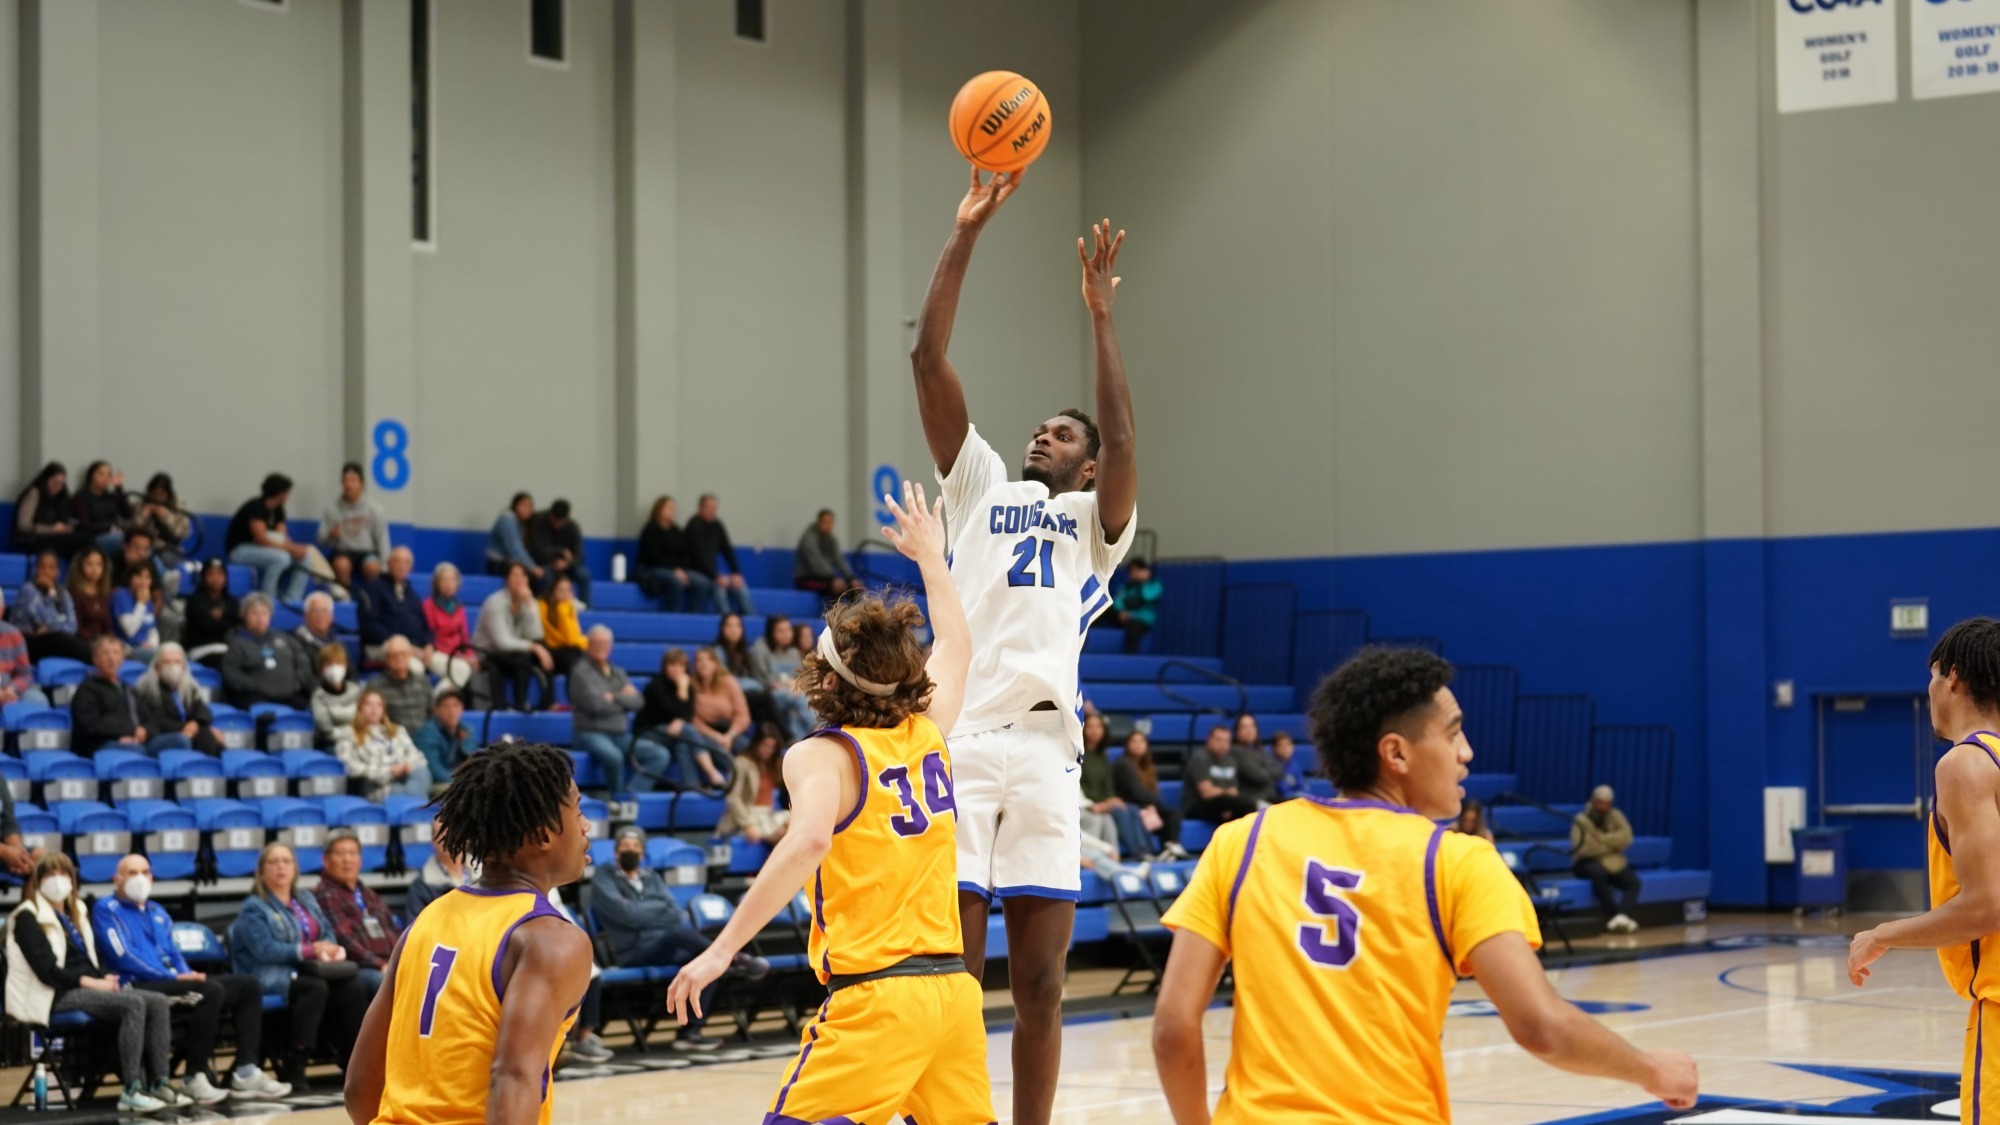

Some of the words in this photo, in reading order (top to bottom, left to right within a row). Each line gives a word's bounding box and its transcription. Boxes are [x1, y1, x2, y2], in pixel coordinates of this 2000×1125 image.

[1820, 50, 1851, 64] GOLF
[1938, 24, 2000, 41] WOMEN'
[1955, 42, 1990, 58] GOLF
[981, 87, 1032, 136] Wilson
[1011, 112, 1046, 152] NCAA
[372, 418, 410, 491] 8
[873, 466, 902, 526] 9
[1007, 535, 1055, 589] 21
[879, 750, 958, 837] 34
[1296, 857, 1364, 970] 5
[419, 942, 458, 1038] 1
